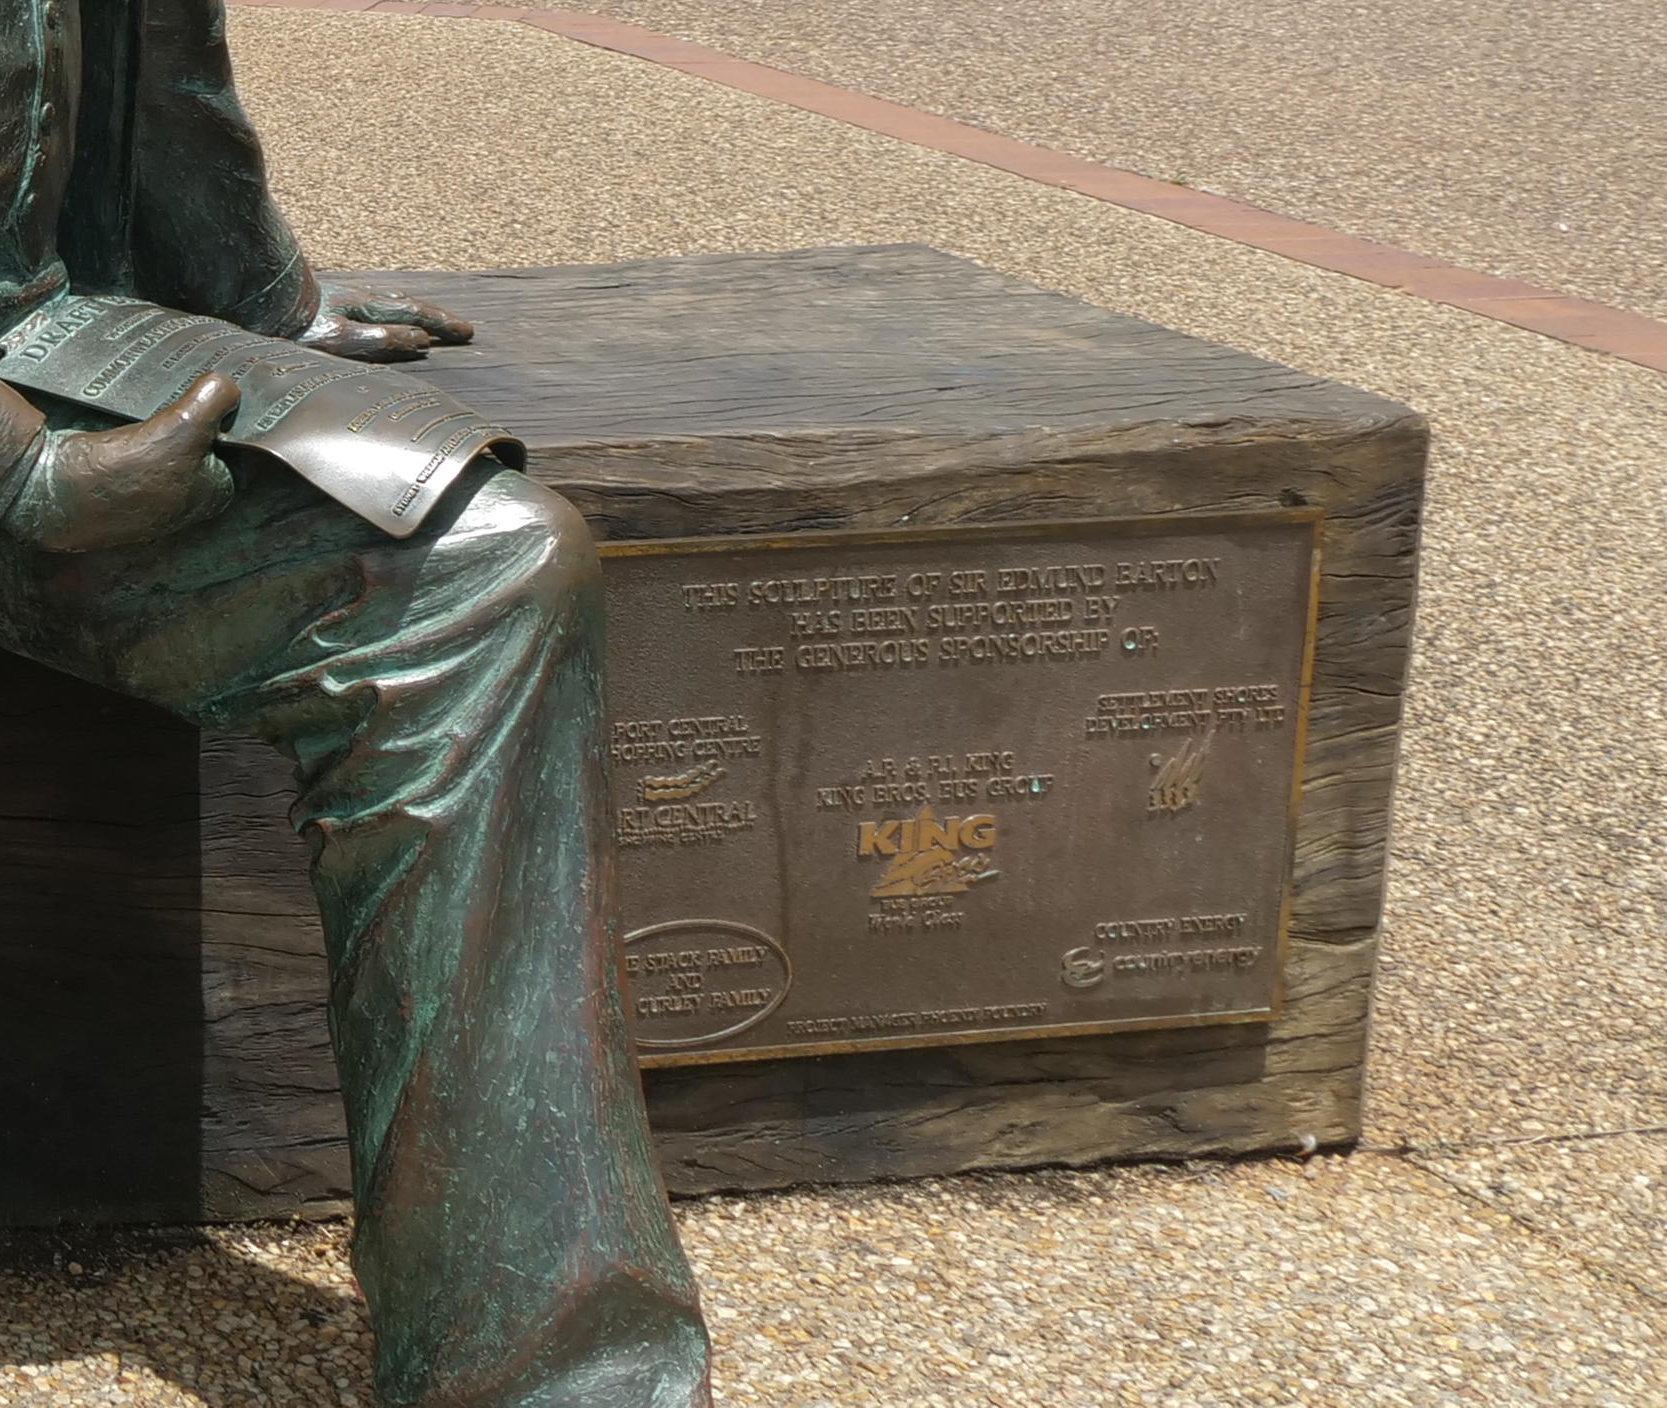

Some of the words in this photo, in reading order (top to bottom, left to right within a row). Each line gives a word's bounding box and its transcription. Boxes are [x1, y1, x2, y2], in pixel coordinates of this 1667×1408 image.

[20, 301, 107, 362] DRAFT
[683, 583, 738, 606] THIS
[748, 575, 897, 604] SCULPTURE
[906, 573, 941, 596] OF
[949, 570, 987, 594] SIR
[997, 564, 1107, 591] EDMUND
[1115, 558, 1220, 585] BARTON
[790, 610, 840, 635] HAS
[851, 607, 917, 632] BEEN
[926, 598, 1073, 628] SUPPORTED
[1084, 596, 1120, 619] BY
[734, 647, 784, 671] THE
[796, 638, 929, 668] GENEROUS
[939, 629, 1109, 659] SPONSORSHIP
[668, 715, 749, 736] CENTRAL
[693, 736, 761, 756] CENTRE
[966, 751, 1014, 772] KING
[817, 785, 865, 806] KING
[939, 778, 977, 798] BUS
[987, 774, 1054, 796] GROUP
[654, 800, 757, 827] CENTRAL
[858, 814, 998, 855] KING
[1095, 918, 1175, 938] COUNTRY
[1180, 913, 1247, 933] ENERGY
[645, 950, 701, 970] STACK
[707, 946, 769, 965] FAMILY
[669, 972, 703, 989] AND
[709, 988, 771, 1007] FAMILY
